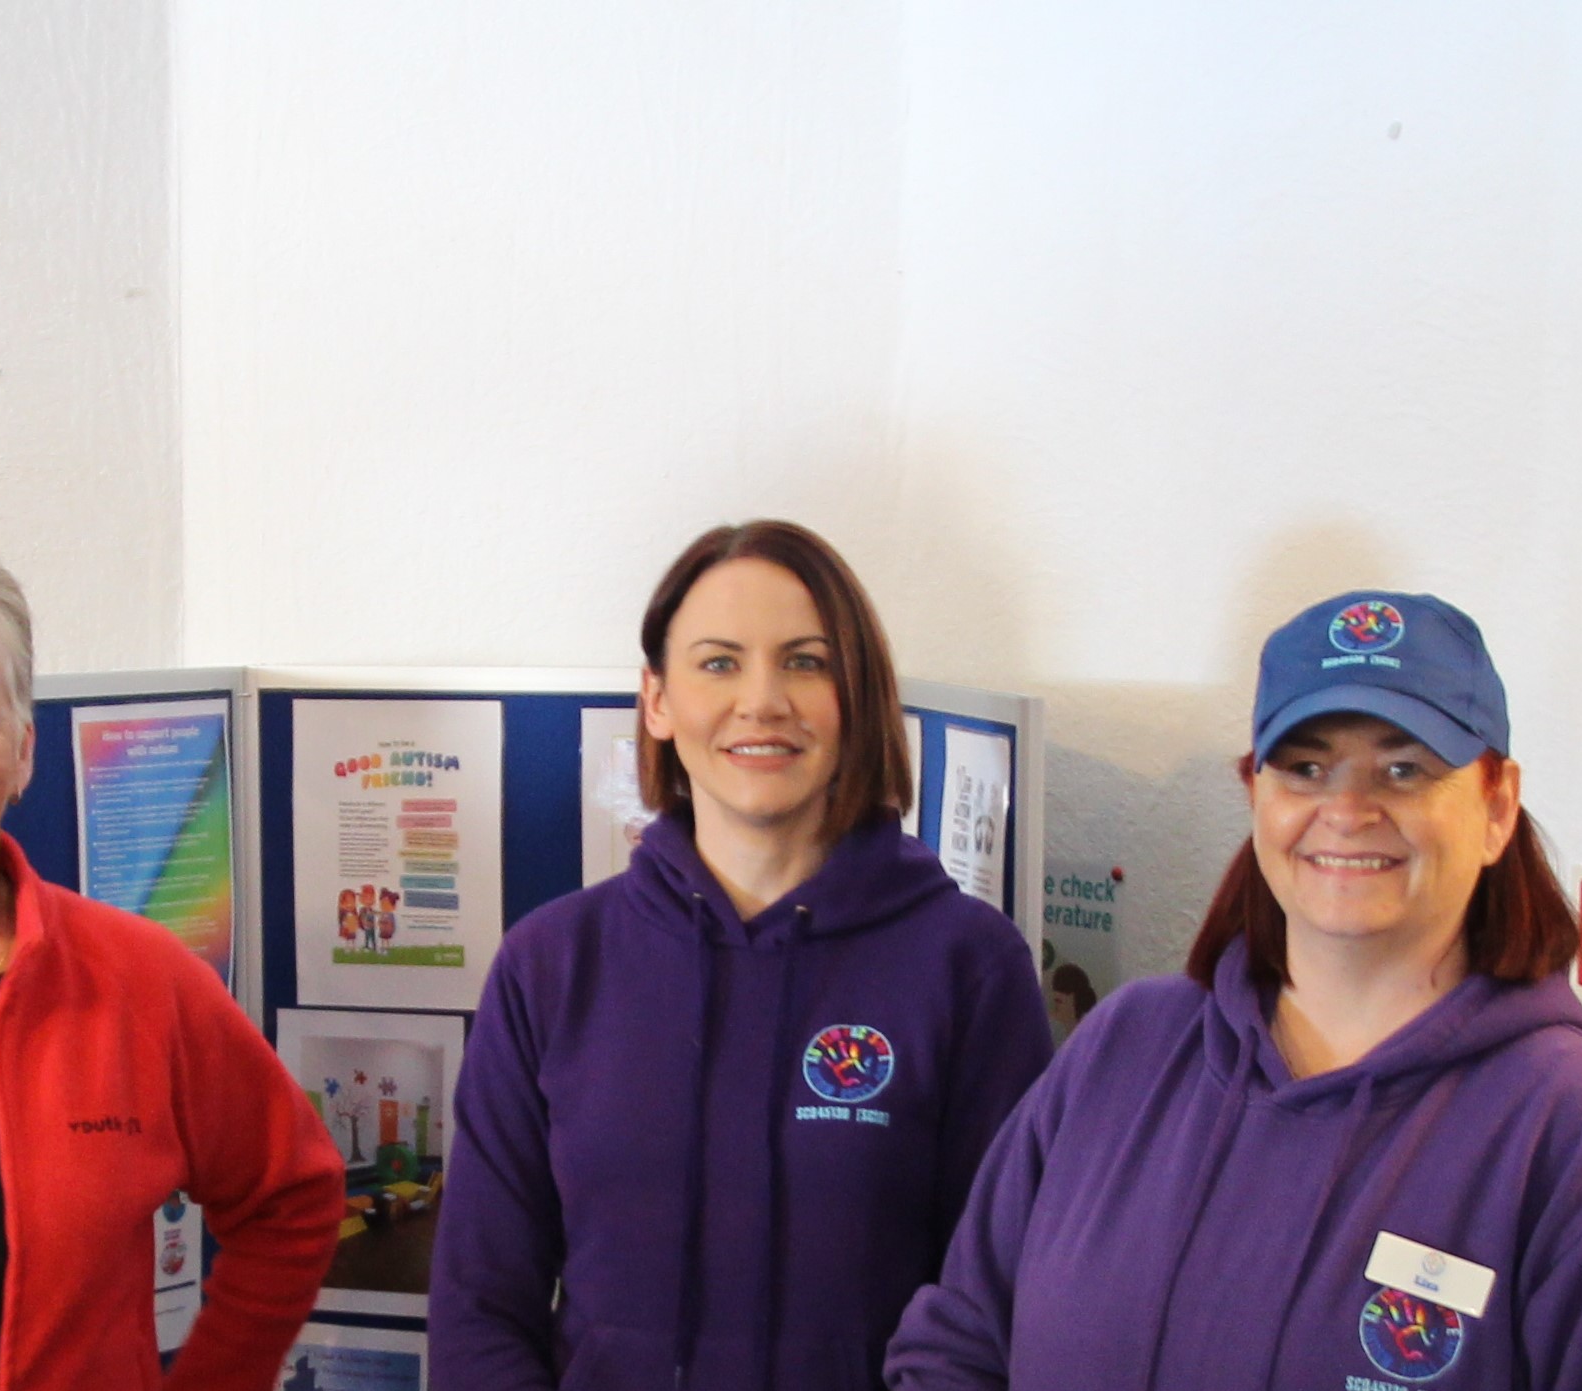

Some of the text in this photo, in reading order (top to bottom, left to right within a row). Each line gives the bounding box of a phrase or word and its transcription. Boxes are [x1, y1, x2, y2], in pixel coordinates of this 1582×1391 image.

[334, 751, 459, 777] GOOD AUTISM
[361, 771, 433, 790] FRIEND!
[1060, 875, 1115, 902] check
